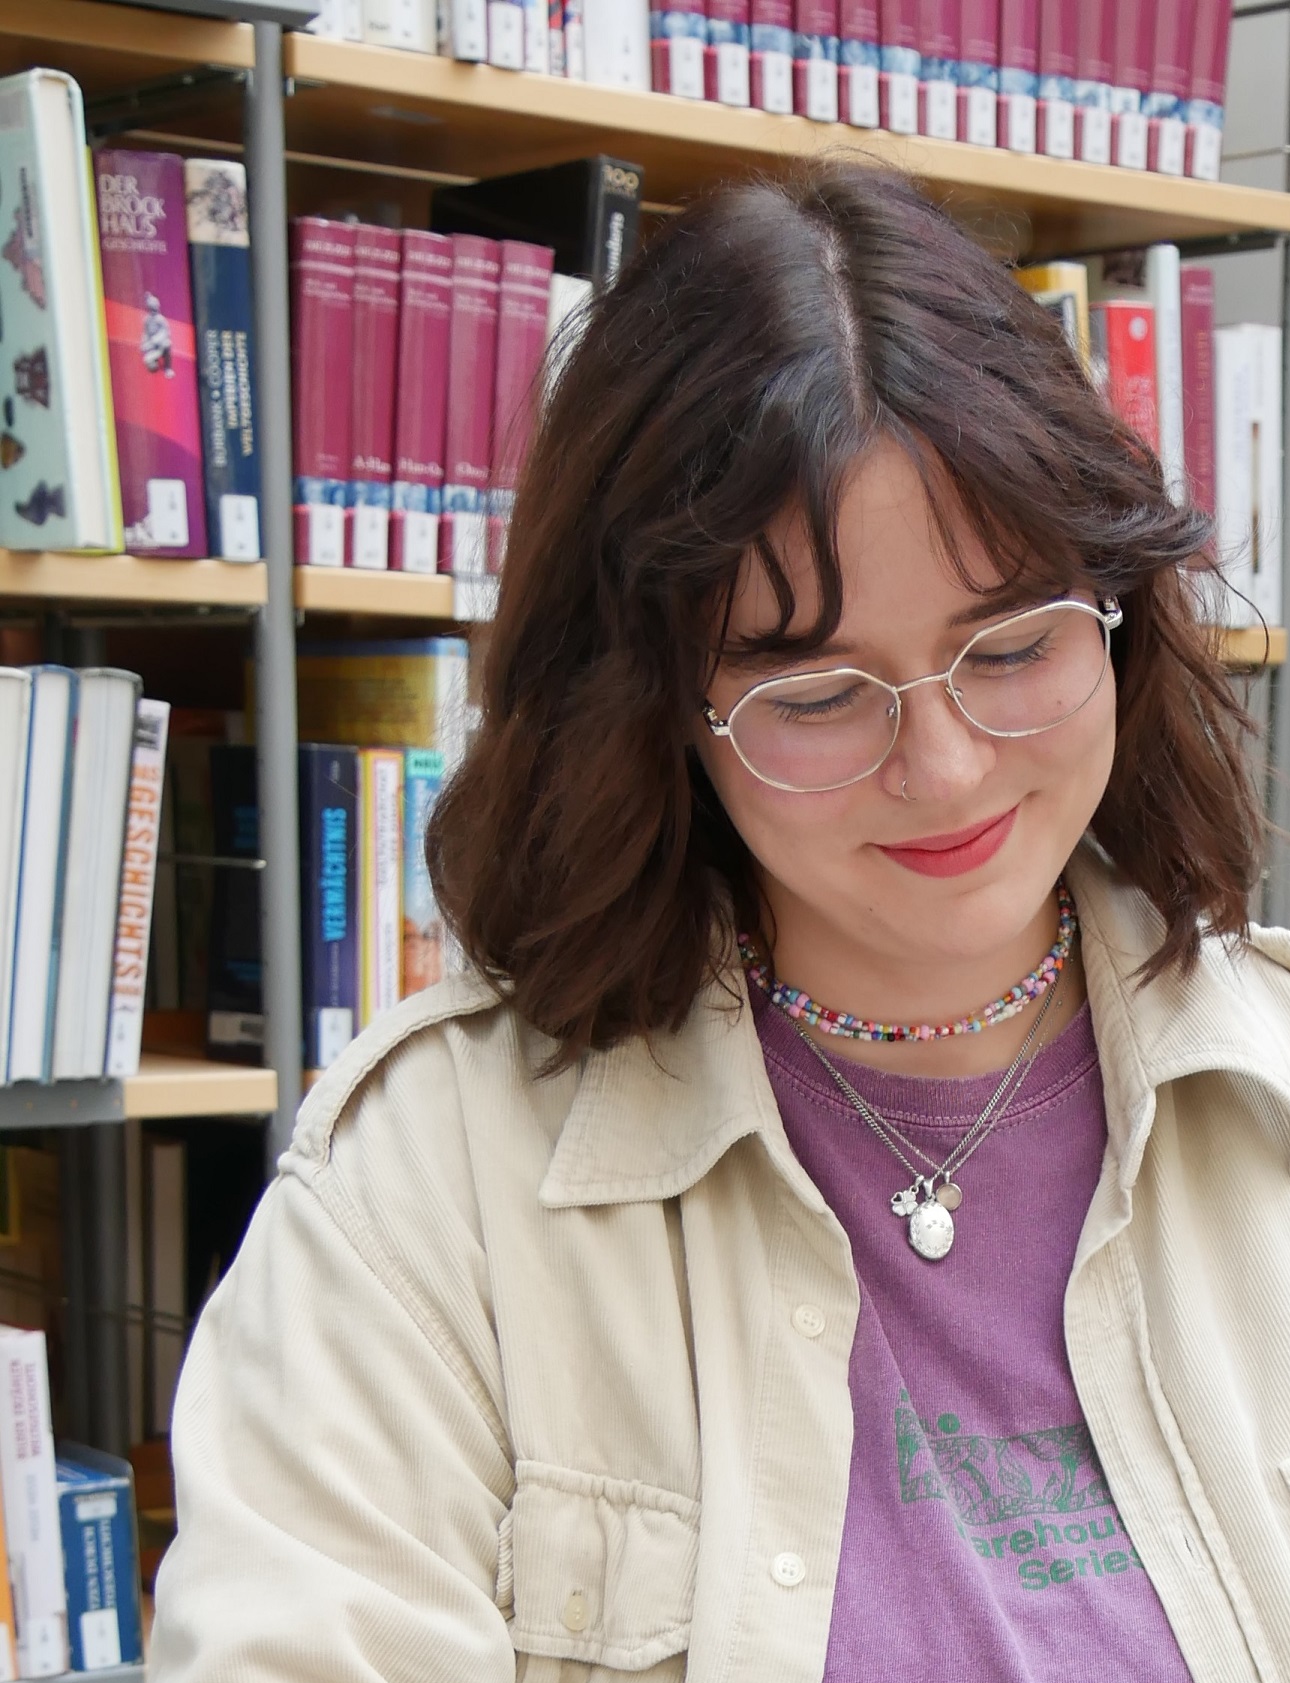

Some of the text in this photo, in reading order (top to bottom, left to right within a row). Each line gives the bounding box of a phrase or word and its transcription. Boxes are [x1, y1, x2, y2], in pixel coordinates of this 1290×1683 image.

[99, 174, 140, 195] DER
[205, 330, 223, 389] COOPER
[221, 330, 239, 429] IMPERIEN DER
[235, 331, 253, 456] WELTGESCHICHTE
[321, 807, 347, 942] VERMÄCHTNIS
[956, 1514, 1128, 1559] arehou
